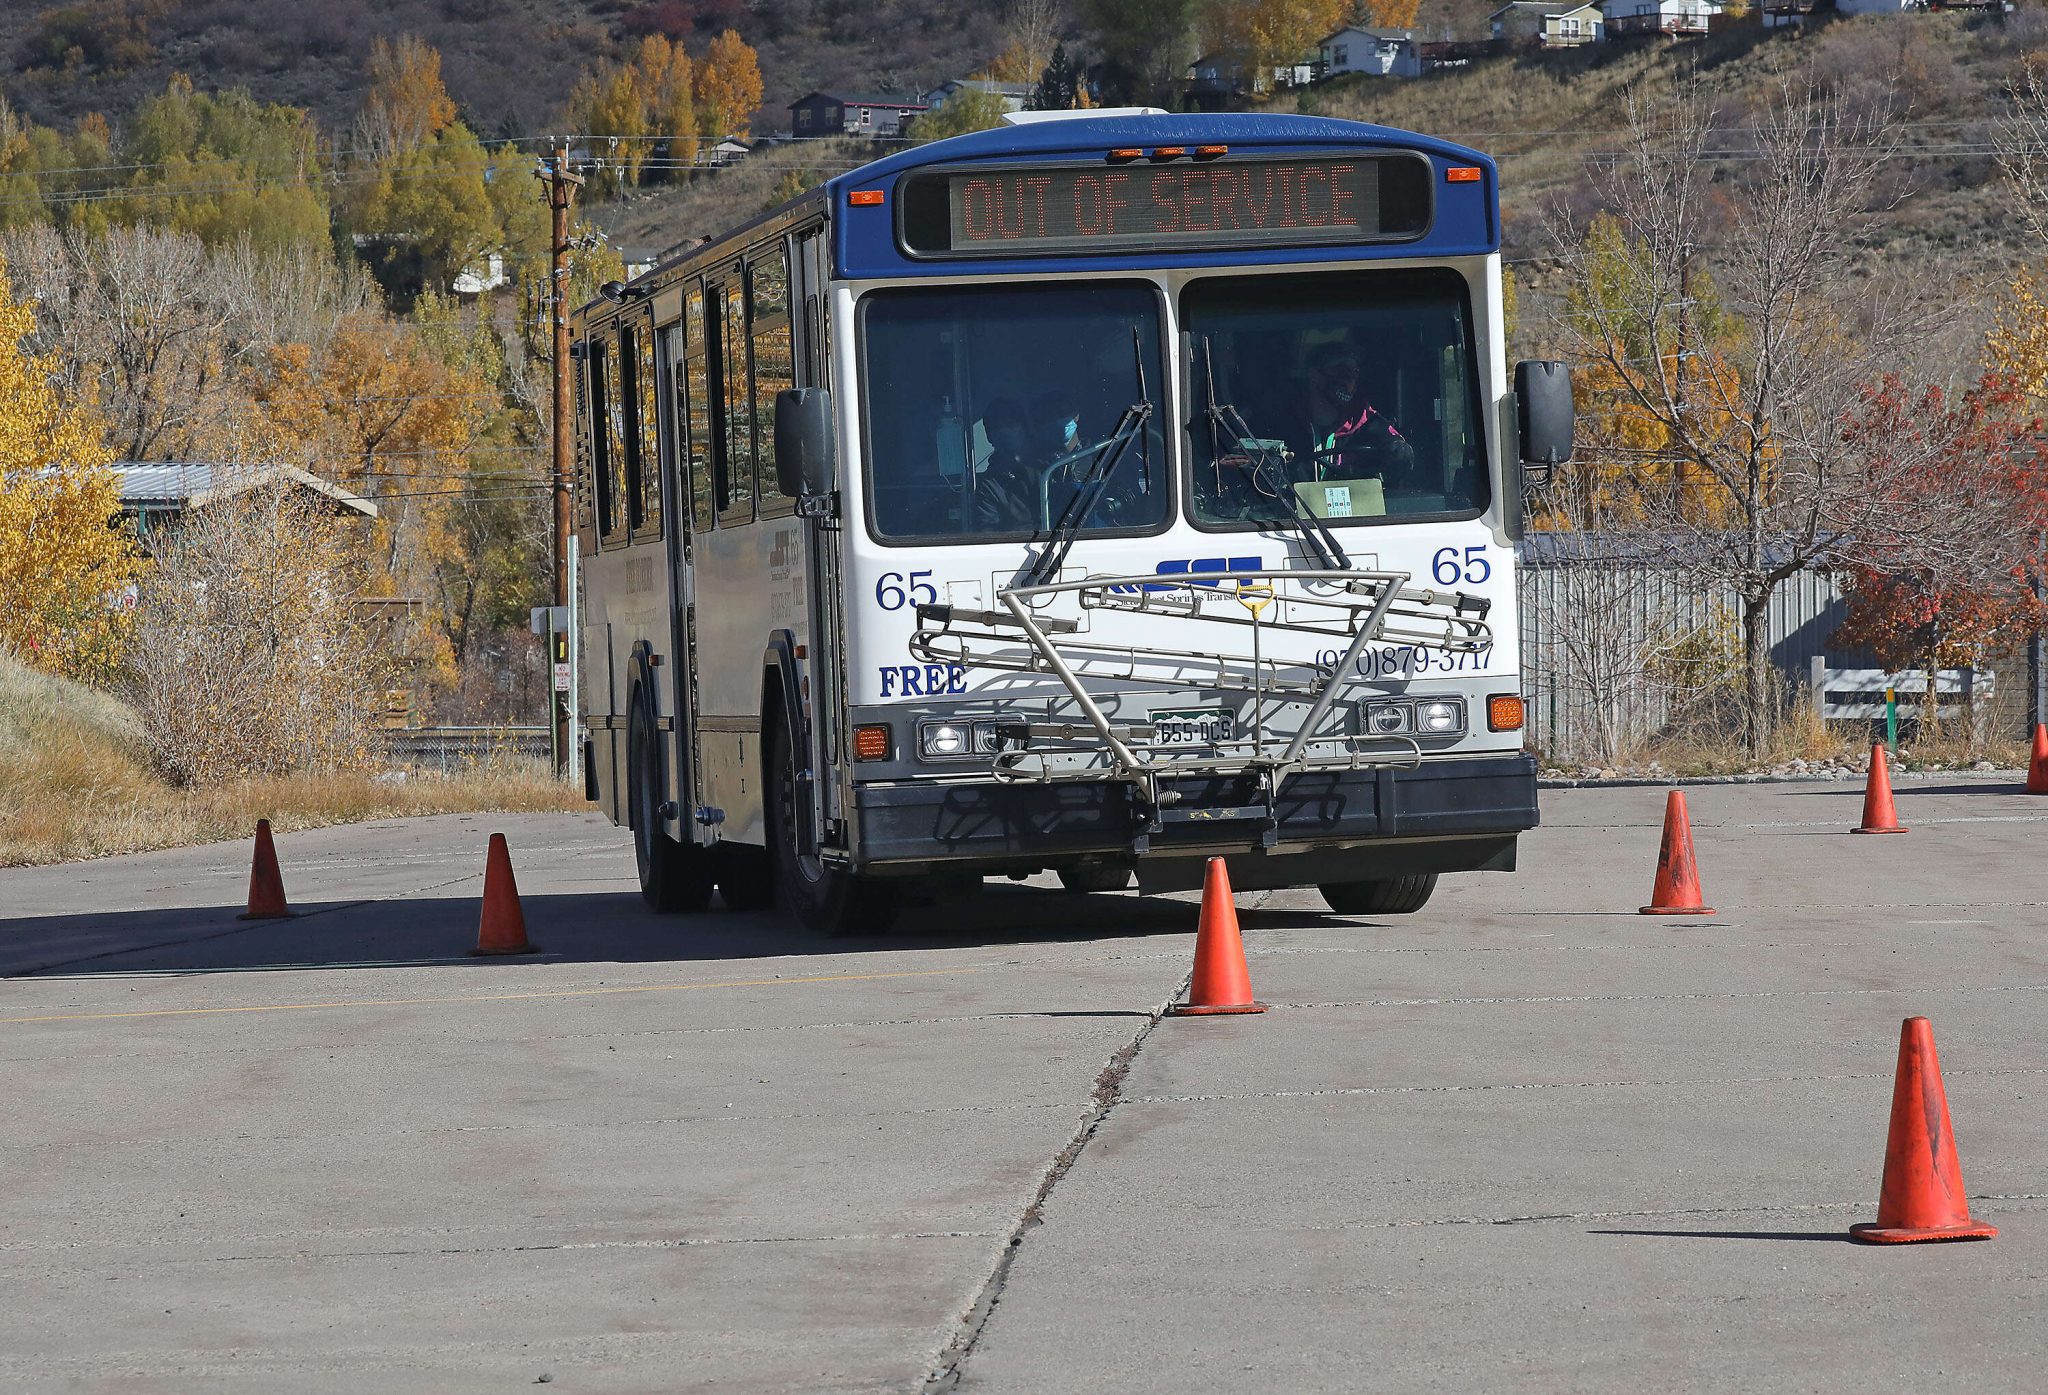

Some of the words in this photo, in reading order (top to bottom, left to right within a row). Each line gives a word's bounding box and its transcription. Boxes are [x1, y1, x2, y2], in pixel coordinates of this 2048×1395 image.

[964, 177, 1051, 240] OUT
[1074, 173, 1129, 235] OF
[1151, 165, 1358, 233] SERVICE
[1432, 544, 1491, 586] 65
[875, 569, 937, 611] 65
[878, 664, 968, 697] FREE
